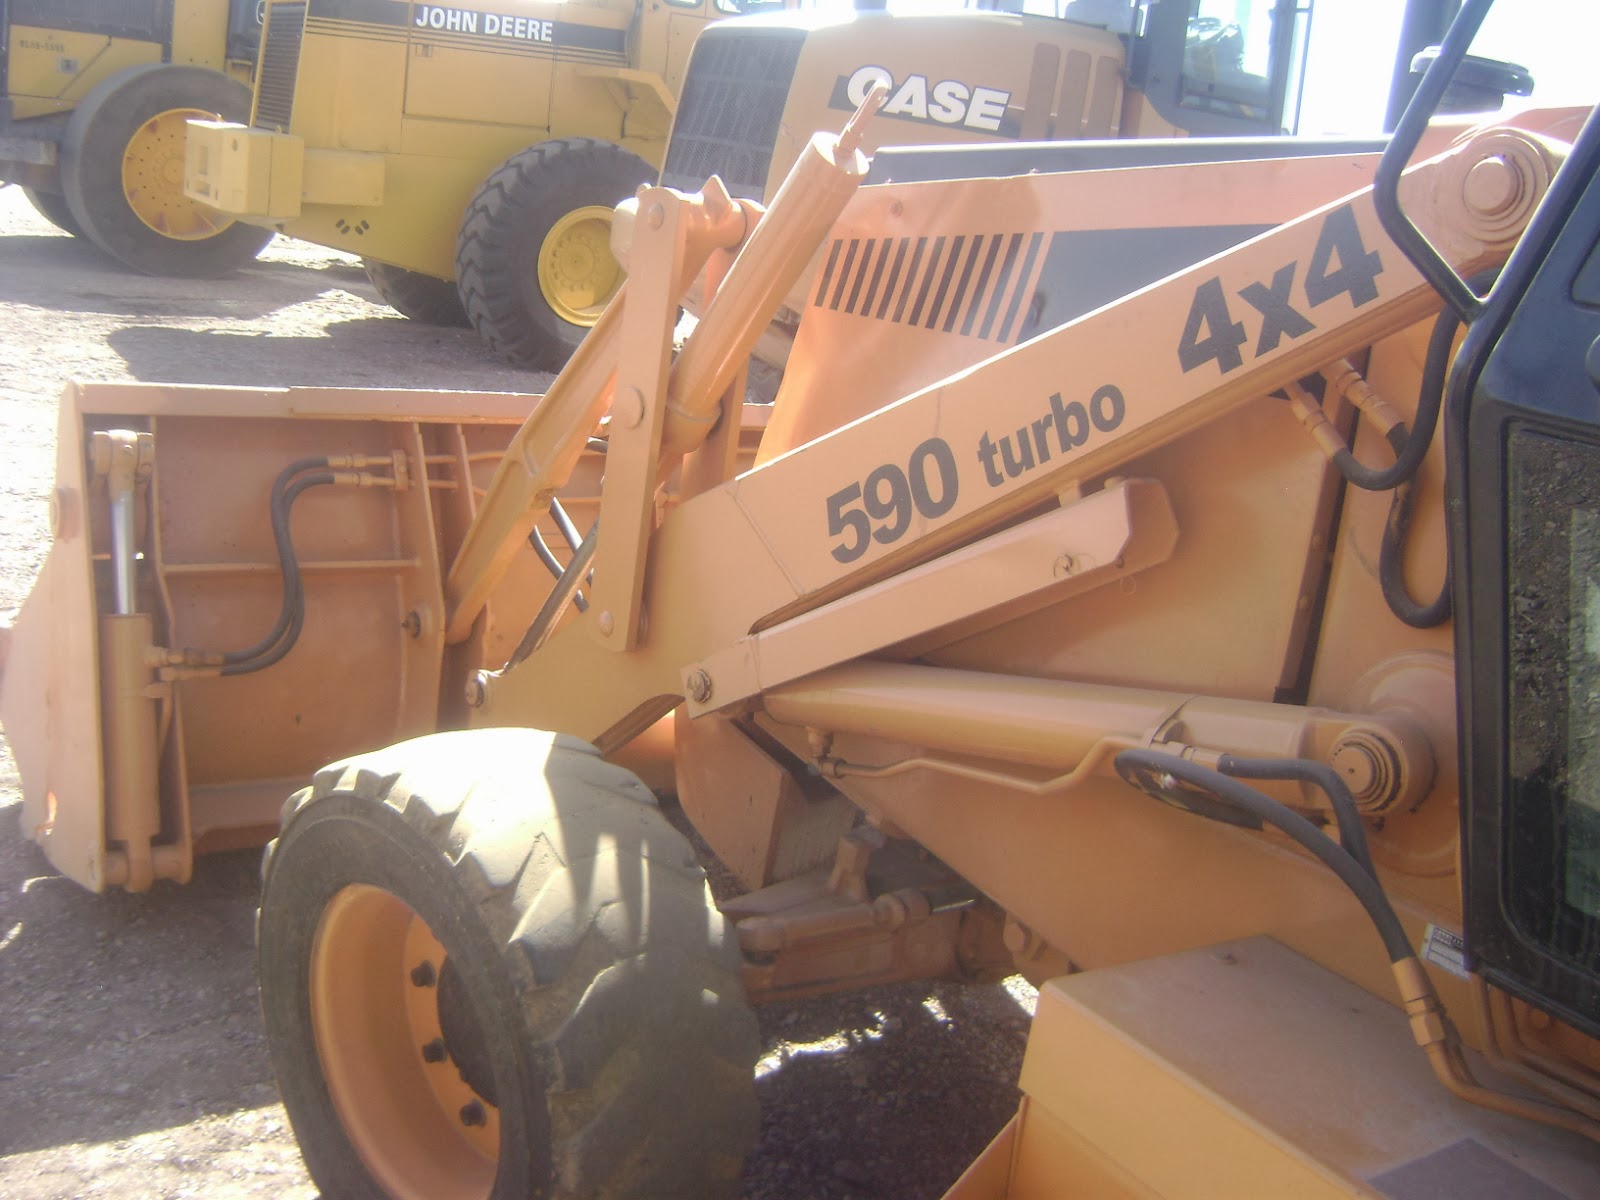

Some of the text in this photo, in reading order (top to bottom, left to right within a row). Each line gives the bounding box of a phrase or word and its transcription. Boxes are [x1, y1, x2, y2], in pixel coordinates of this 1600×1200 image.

[416, 6, 554, 42] JOHN DEERE
[846, 65, 1010, 132] CASE
[1177, 203, 1384, 376] 4x4
[825, 383, 1126, 565] 590 turbo
